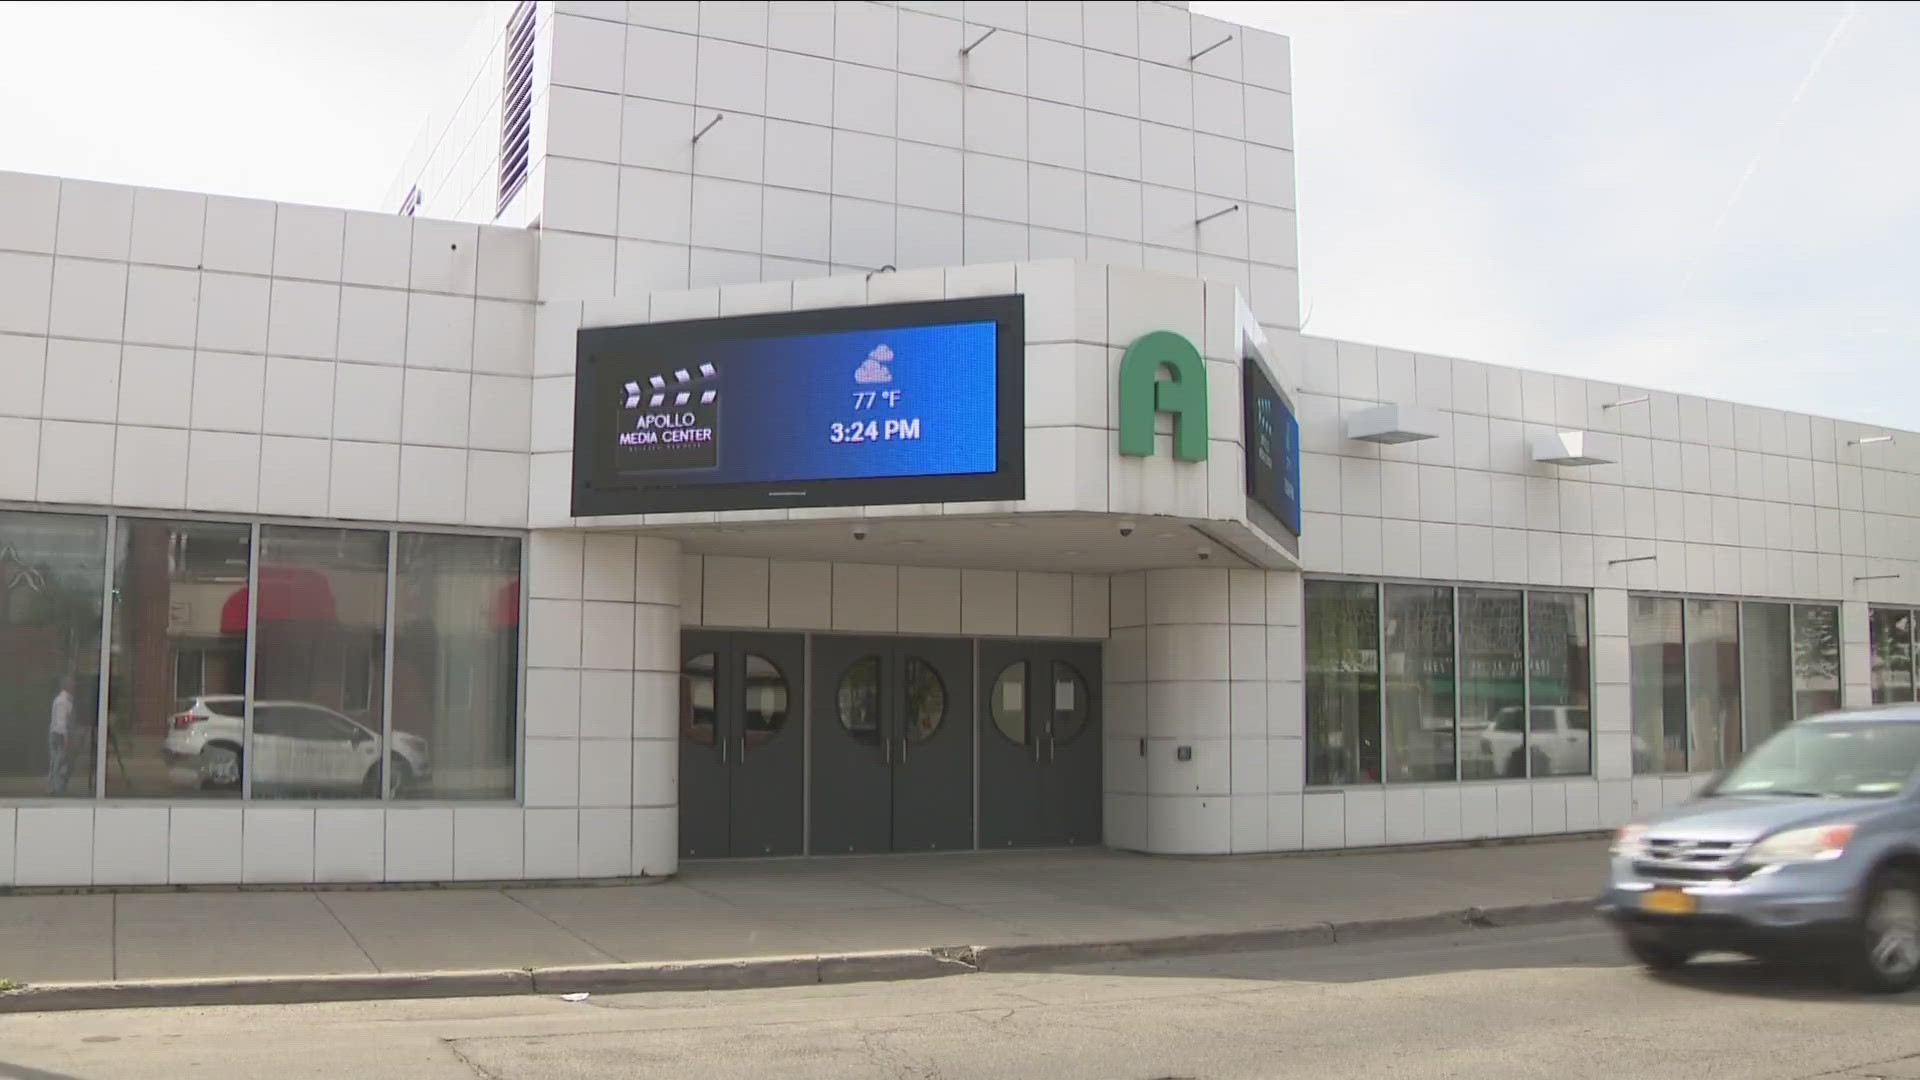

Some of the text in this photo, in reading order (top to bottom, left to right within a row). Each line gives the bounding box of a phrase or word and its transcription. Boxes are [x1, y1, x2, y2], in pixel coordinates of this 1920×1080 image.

[853, 390, 901, 410] 77 °F
[1119, 330, 1208, 463] A
[637, 413, 695, 429] APOLLO
[830, 418, 920, 443] 3:24 PM
[620, 428, 712, 445] MEDIA CENTER
